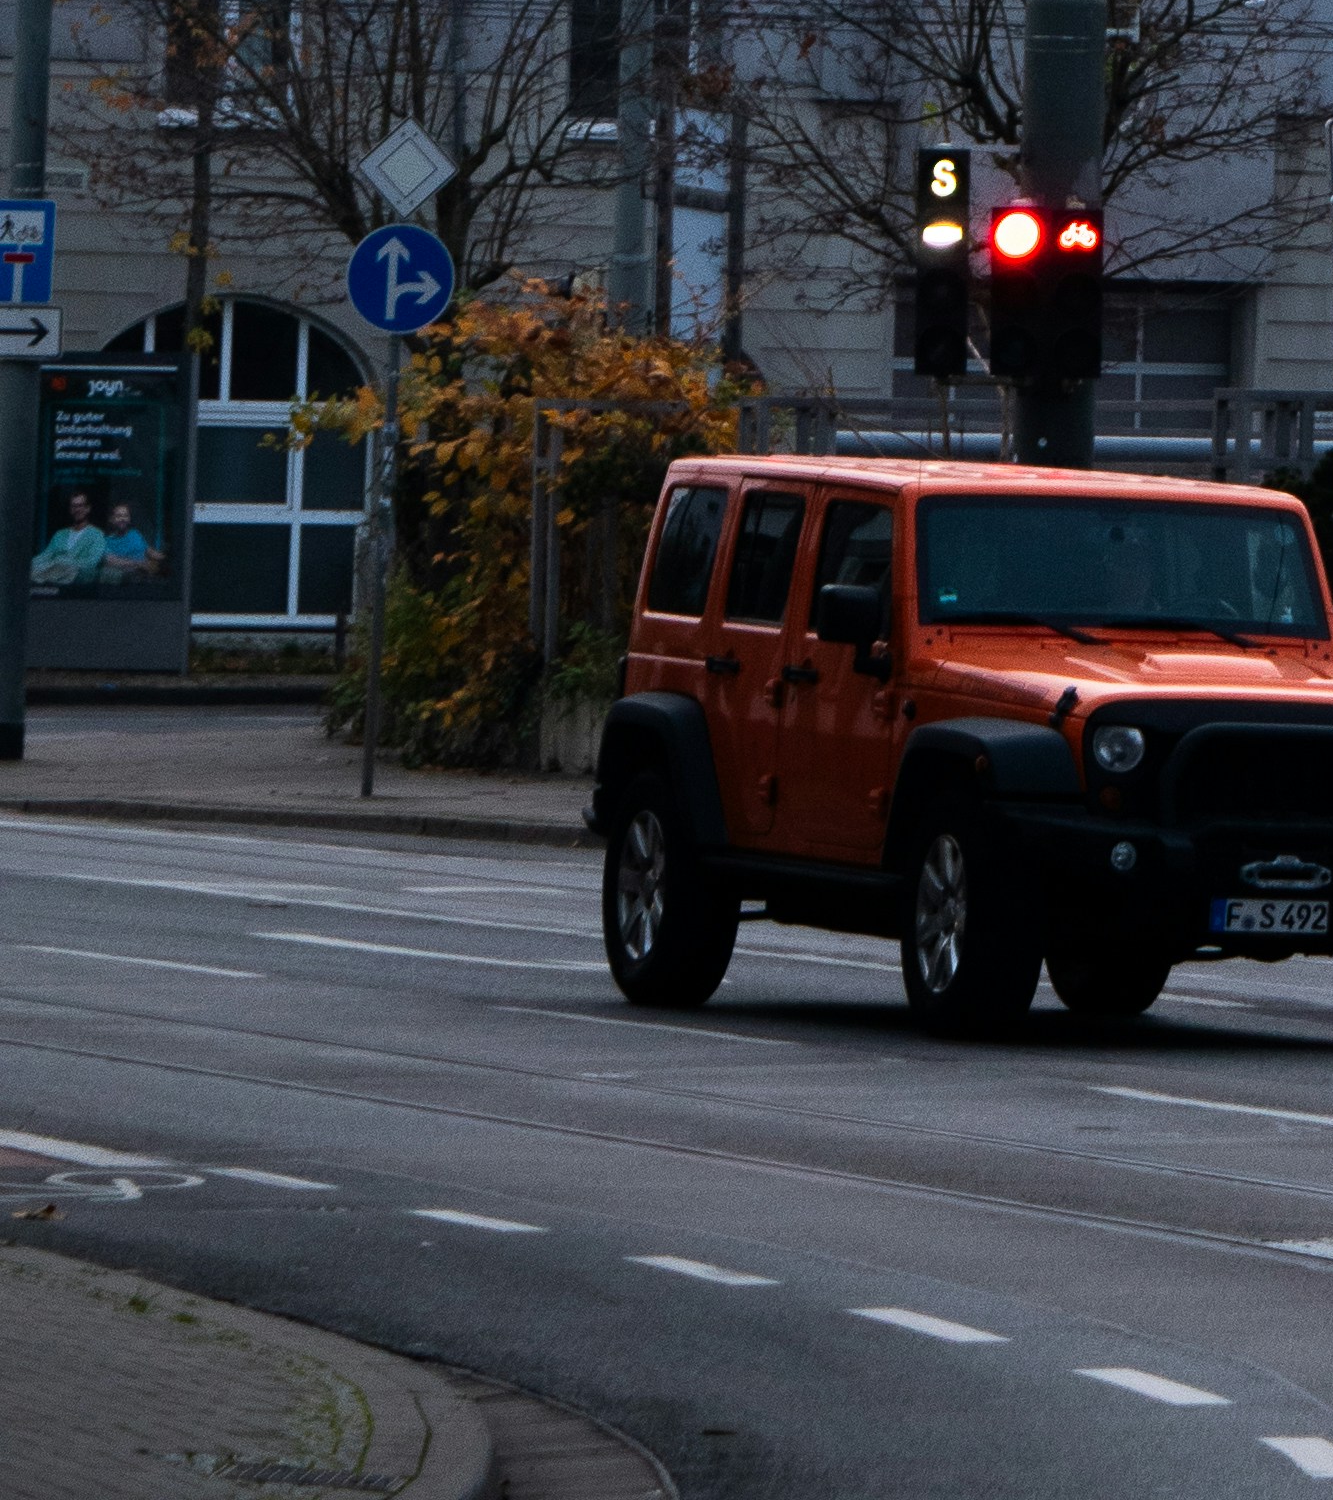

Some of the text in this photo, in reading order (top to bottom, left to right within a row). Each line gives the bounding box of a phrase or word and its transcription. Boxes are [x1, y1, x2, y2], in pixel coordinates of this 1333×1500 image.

[1227, 903, 1326, 930] F S 492
